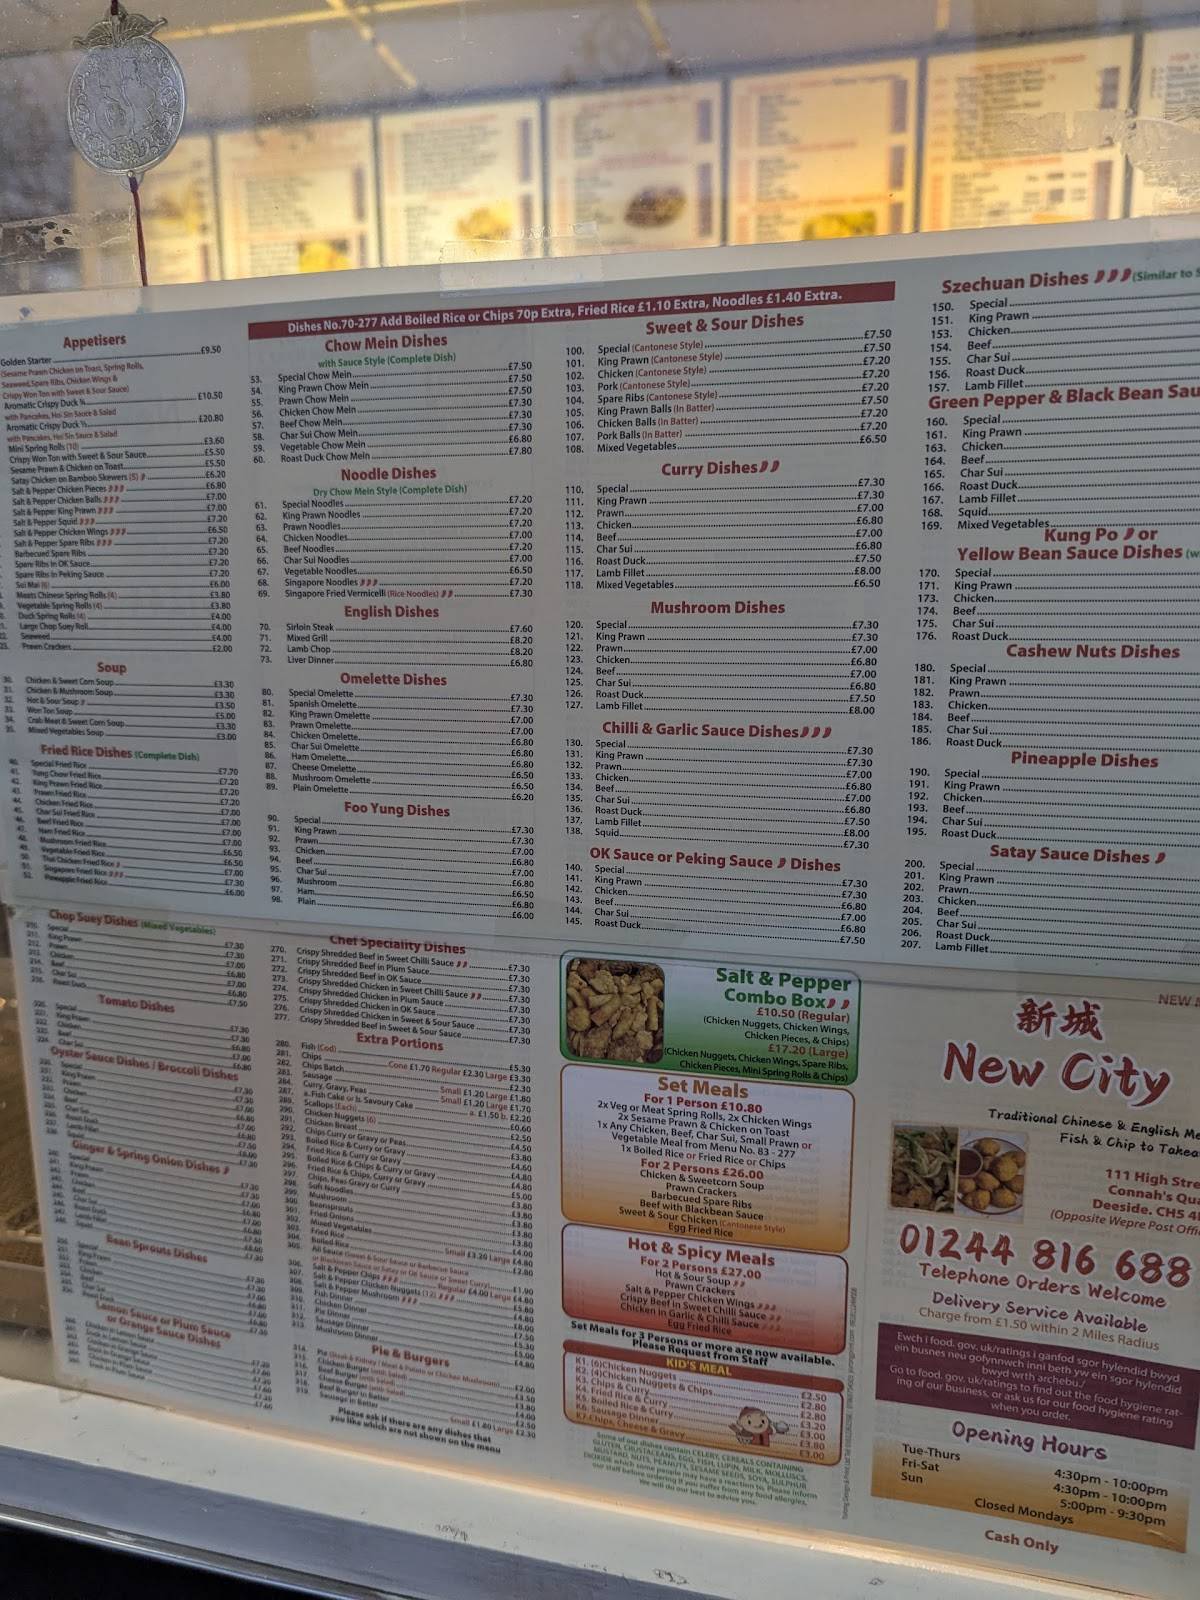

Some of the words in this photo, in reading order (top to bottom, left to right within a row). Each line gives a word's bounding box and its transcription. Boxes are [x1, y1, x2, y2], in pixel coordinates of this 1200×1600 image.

[941, 276, 1024, 294] Szechuan
[1029, 272, 1088, 287] Dishes
[1132, 269, 1177, 281] (Similar
[1180, 269, 1192, 278] to
[287, 321, 321, 333] Dishes
[323, 317, 377, 330] No.70-277
[380, 315, 402, 326] Add
[404, 313, 440, 325] Boiled
[442, 312, 465, 323] Rice
[467, 313, 480, 321] or
[482, 310, 514, 323] Chips
[516, 308, 538, 321] 70p
[541, 307, 574, 318] Extra,
[577, 303, 607, 315] Fried
[610, 302, 634, 313] Rice
[637, 299, 671, 312] £1.10
[673, 298, 709, 309] Extra,
[712, 294, 763, 307] Noodles
[766, 291, 801, 303] £1.40
[804, 290, 841, 301] Extra.
[932, 301, 954, 311] 150.
[969, 297, 1007, 310] Special
[646, 319, 692, 335] Sweet
[695, 318, 707, 332] &
[711, 317, 748, 331] Sour
[751, 312, 803, 329] Dishes
[63, 333, 126, 350] Appetisers
[324, 338, 361, 352] Chow
[364, 335, 398, 349] Mein
[401, 333, 447, 347] Dishes
[566, 346, 584, 355] 100.
[597, 343, 630, 354] Special
[631, 343, 677, 352] (Cantonese
[679, 340, 703, 351] Style)
[864, 329, 891, 339] £7.50
[26, 356, 51, 365] Starter
[201, 345, 221, 354] £9.50
[317, 358, 336, 367] with
[337, 358, 362, 367] Sauce
[363, 355, 385, 366] Style
[387, 353, 431, 365] (Complete
[433, 352, 456, 361] Dish)
[250, 375, 262, 383] 53.
[277, 371, 305, 383] Special
[307, 371, 329, 380] Chow
[331, 369, 351, 378] Mein
[508, 361, 532, 370] £7.50
[928, 395, 979, 409] Green
[983, 392, 1045, 408] Pepper
[1048, 389, 1062, 403] &
[1066, 387, 1114, 403] Black
[1118, 386, 1163, 400] Bean
[341, 467, 388, 480] Noodle
[391, 466, 436, 479] Dishes
[661, 463, 703, 478] Curry
[707, 460, 757, 474] Dishes
[1044, 528, 1090, 544] Kung
[1095, 527, 1118, 541] Po
[1138, 529, 1158, 540] or
[957, 546, 1014, 560] Yellow
[1018, 546, 1061, 560] Bean
[1066, 545, 1118, 559] Sauce
[1122, 545, 1182, 559] Dishes
[565, 568, 583, 577] 117.
[596, 568, 620, 577] Lamb
[623, 567, 644, 576] Fillet
[854, 566, 881, 575] £8.00
[257, 589, 270, 597] 69.
[284, 589, 324, 599] Singapore
[325, 588, 345, 597] Fried
[346, 588, 386, 597] Vermicelli
[509, 588, 532, 597] £7.30
[344, 604, 392, 620] English
[394, 605, 439, 617] Dishes
[650, 600, 730, 613] Mushroom
[734, 600, 785, 613] Dishes
[1006, 643, 1071, 657] Cashew
[1076, 644, 1116, 658] Nuts
[1120, 644, 1180, 658] Dishes
[97, 661, 126, 675] Soup
[340, 672, 400, 685] Omelette
[403, 673, 447, 685] Dishes
[602, 721, 638, 734] Chilli
[641, 722, 652, 734] &
[655, 722, 698, 735] Garlic
[701, 723, 744, 736] Sauce
[748, 724, 798, 738] Dishes
[40, 743, 69, 755] Fried
[70, 745, 93, 756] Rice
[95, 746, 132, 758] Dishes
[1011, 750, 1096, 768] Pineapple
[1100, 753, 1158, 767] Dishes
[344, 801, 367, 813] Foo
[370, 802, 403, 817] Yung
[406, 804, 449, 817] Dishes
[589, 847, 610, 859] OK
[613, 848, 654, 861] Sauce
[657, 853, 672, 862] or
[676, 851, 725, 868] Peking
[729, 854, 772, 868] Sauce
[790, 857, 840, 871] Dishes
[989, 844, 1036, 861] Satay
[1039, 846, 1089, 861] Sauce
[1093, 848, 1149, 863] Dishes
[900, 939, 920, 948] 207.
[935, 941, 962, 951] Lamb
[964, 943, 988, 952] Fillet
[716, 967, 754, 984] Salt
[758, 970, 773, 985] &
[778, 972, 852, 993] Pepper
[724, 987, 787, 1005] Combo
[791, 992, 825, 1008] Box
[1016, 998, 1104, 1041] 新城
[356, 1031, 388, 1045] Extra
[391, 1035, 443, 1050] Portions
[943, 1042, 1045, 1087] New
[1061, 1052, 1171, 1107] City
[658, 1076, 687, 1093] Set
[692, 1079, 748, 1098] Meals
[644, 1092, 663, 1103] For
[666, 1095, 672, 1105] 1
[676, 1096, 717, 1109] Person
[720, 1101, 762, 1113] £10.80
[628, 1236, 657, 1252] Hot
[661, 1241, 673, 1254] &
[677, 1243, 721, 1263] Spicy
[725, 1249, 774, 1266] Meals
[899, 1223, 1015, 1266] 01244
[1031, 1239, 1096, 1274] 816
[1115, 1249, 1191, 1288] 688
[918, 1262, 1009, 1286] Telephone
[1015, 1274, 1080, 1295] Orders
[1087, 1282, 1166, 1308] Welcome
[932, 1291, 1000, 1313] Delivery
[1005, 1300, 1068, 1320] Service
[1073, 1309, 1148, 1332] Available
[666, 1357, 696, 1371] KID'S
[699, 1362, 732, 1375] MEAL
[952, 1420, 1034, 1452] Opening
[1041, 1434, 1107, 1460] Hours
[902, 1443, 960, 1461] Tue-Thurs
[1054, 1468, 1100, 1485] 4:30pm
[1112, 1478, 1168, 1496] 10:00pm
[984, 1529, 1019, 1545] Cash
[1023, 1536, 1058, 1554] Only
